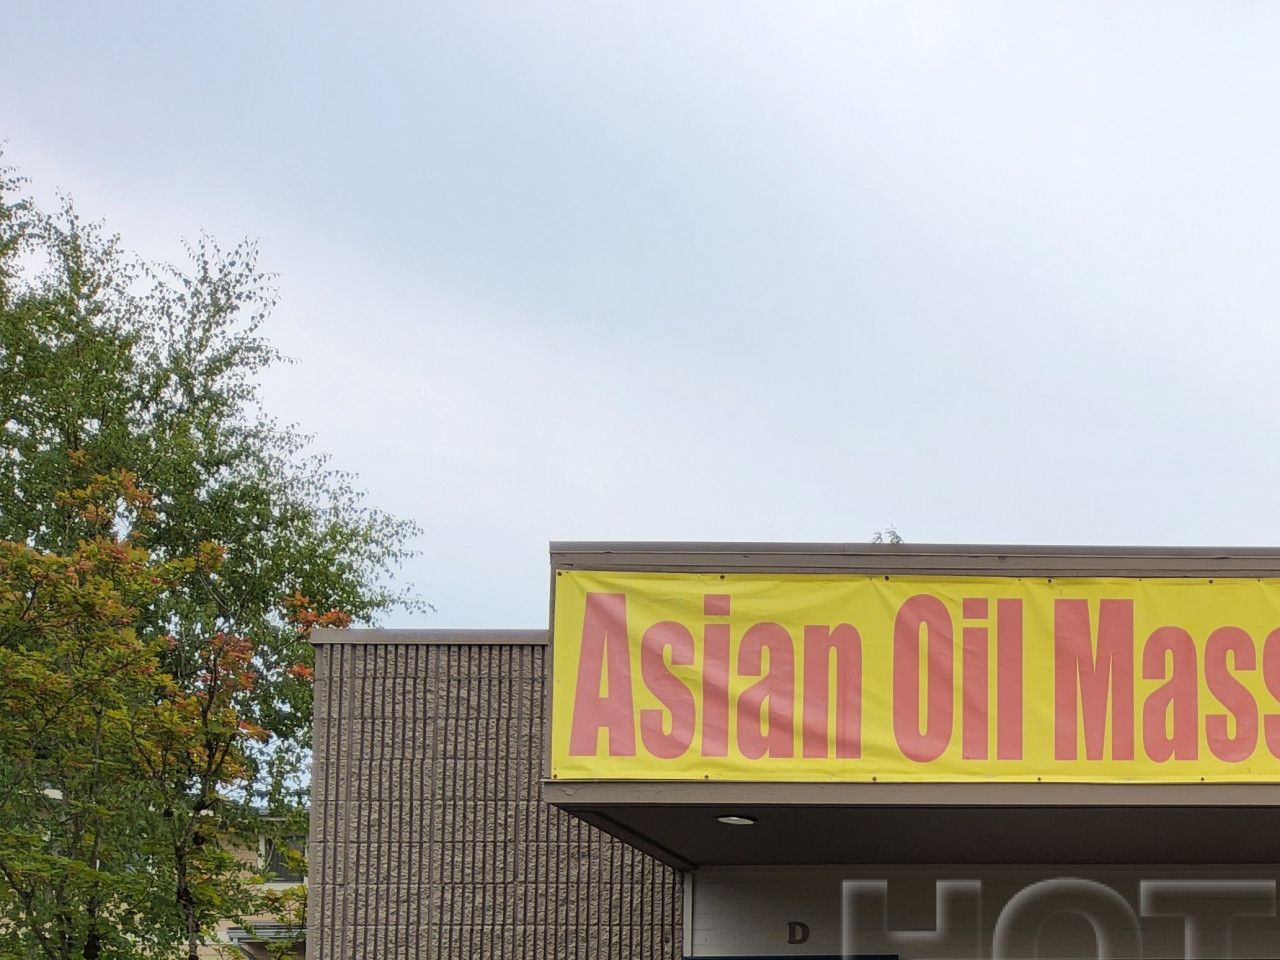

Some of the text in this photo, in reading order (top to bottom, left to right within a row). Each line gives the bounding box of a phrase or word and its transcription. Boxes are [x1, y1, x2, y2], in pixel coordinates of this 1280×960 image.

[568, 591, 863, 761] Asian
[892, 594, 1024, 764] Oil
[787, 921, 810, 945] D
